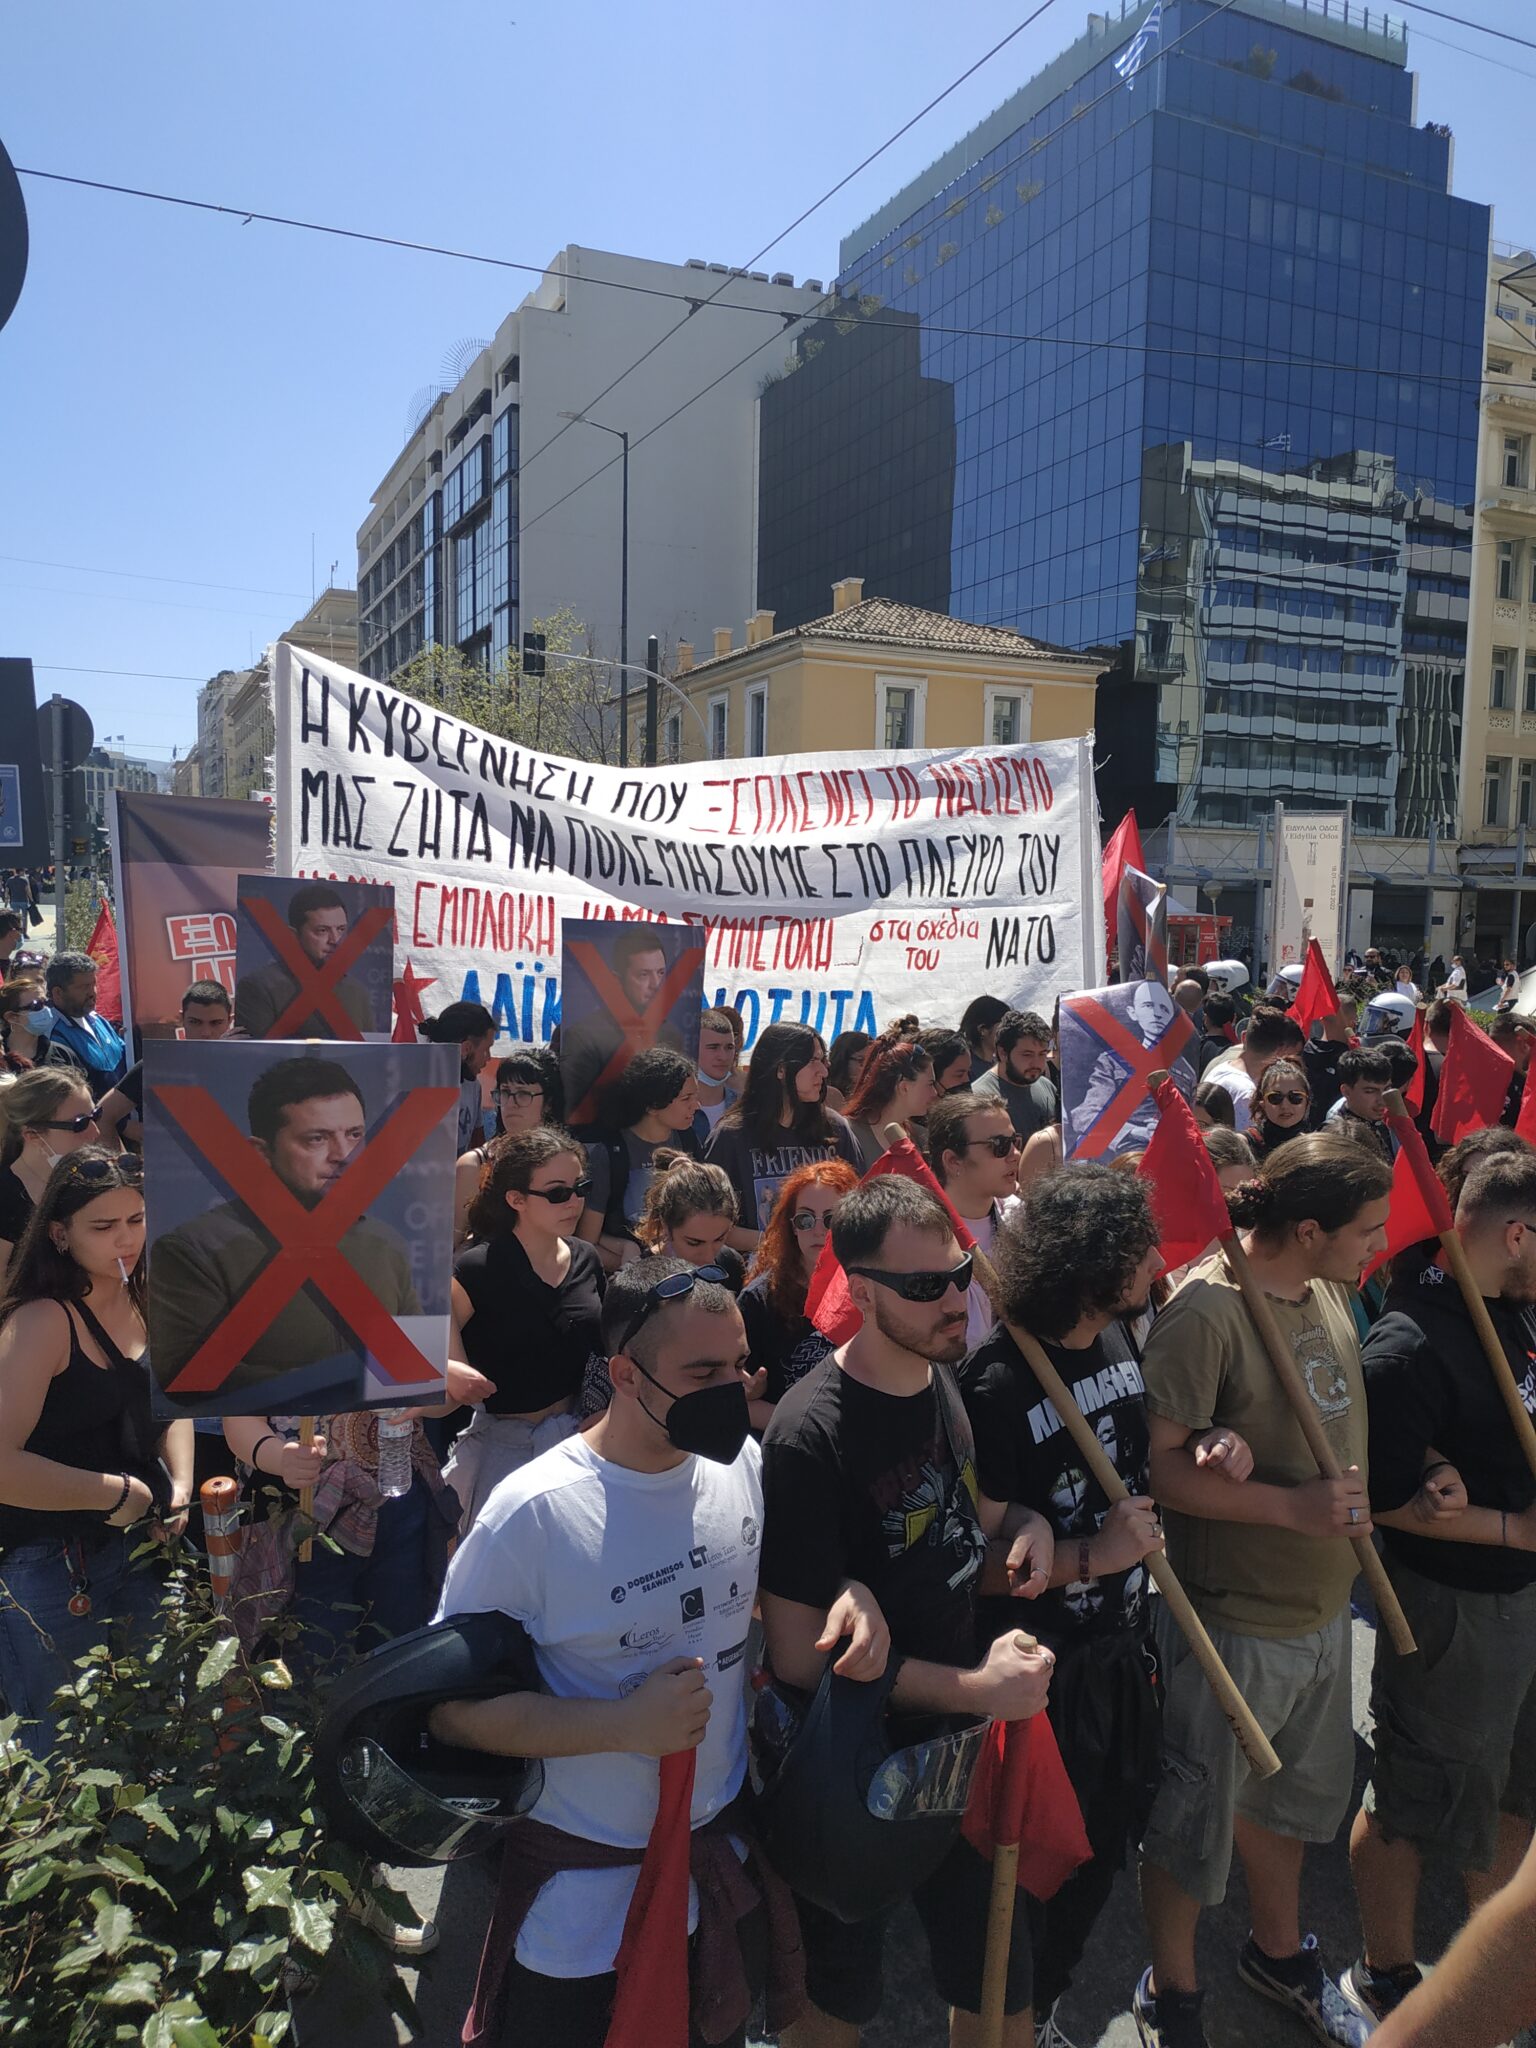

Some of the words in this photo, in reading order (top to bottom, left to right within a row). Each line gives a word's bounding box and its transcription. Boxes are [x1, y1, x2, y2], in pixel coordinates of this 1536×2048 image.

[301, 668, 330, 747] Η
[347, 682, 594, 806] ΚΥΒΕΡΝΗΣΗ
[610, 780, 688, 824] ΠΟΥ
[689, 767, 874, 836] ΞΕΠΛΕΝΕΙ
[875, 764, 922, 821] ΤΟ
[927, 755, 1055, 820] ΝΑΖΙΣΜΟ
[300, 767, 376, 851] ΜΑΣ
[387, 780, 492, 863] ΖΗΤΑ
[508, 799, 555, 874] ΝΑ
[563, 814, 823, 900] ΠΟΛΕΜΗΣΟΥΜΕ
[822, 842, 892, 899] ΣΤΟ
[898, 833, 1004, 899] ΠΛΕΥΡΟ
[1018, 832, 1061, 897] ΤΟΥ
[1285, 824, 1317, 832] ΕΙΔΥΛΛΙΑ
[1319, 824, 1339, 832] ΟΔΟΣ
[1290, 832, 1317, 840] Eidyllia
[1319, 832, 1339, 840] Odos
[412, 880, 555, 957] ΕΜΠΛΟΚΗ
[869, 919, 910, 943] στα
[916, 906, 979, 942] σχέδια
[985, 913, 1056, 971] ΝΑΤΟ
[627, 1560, 685, 1590] DODEKANISOS
[641, 1574, 677, 1594] SEAWAYS
